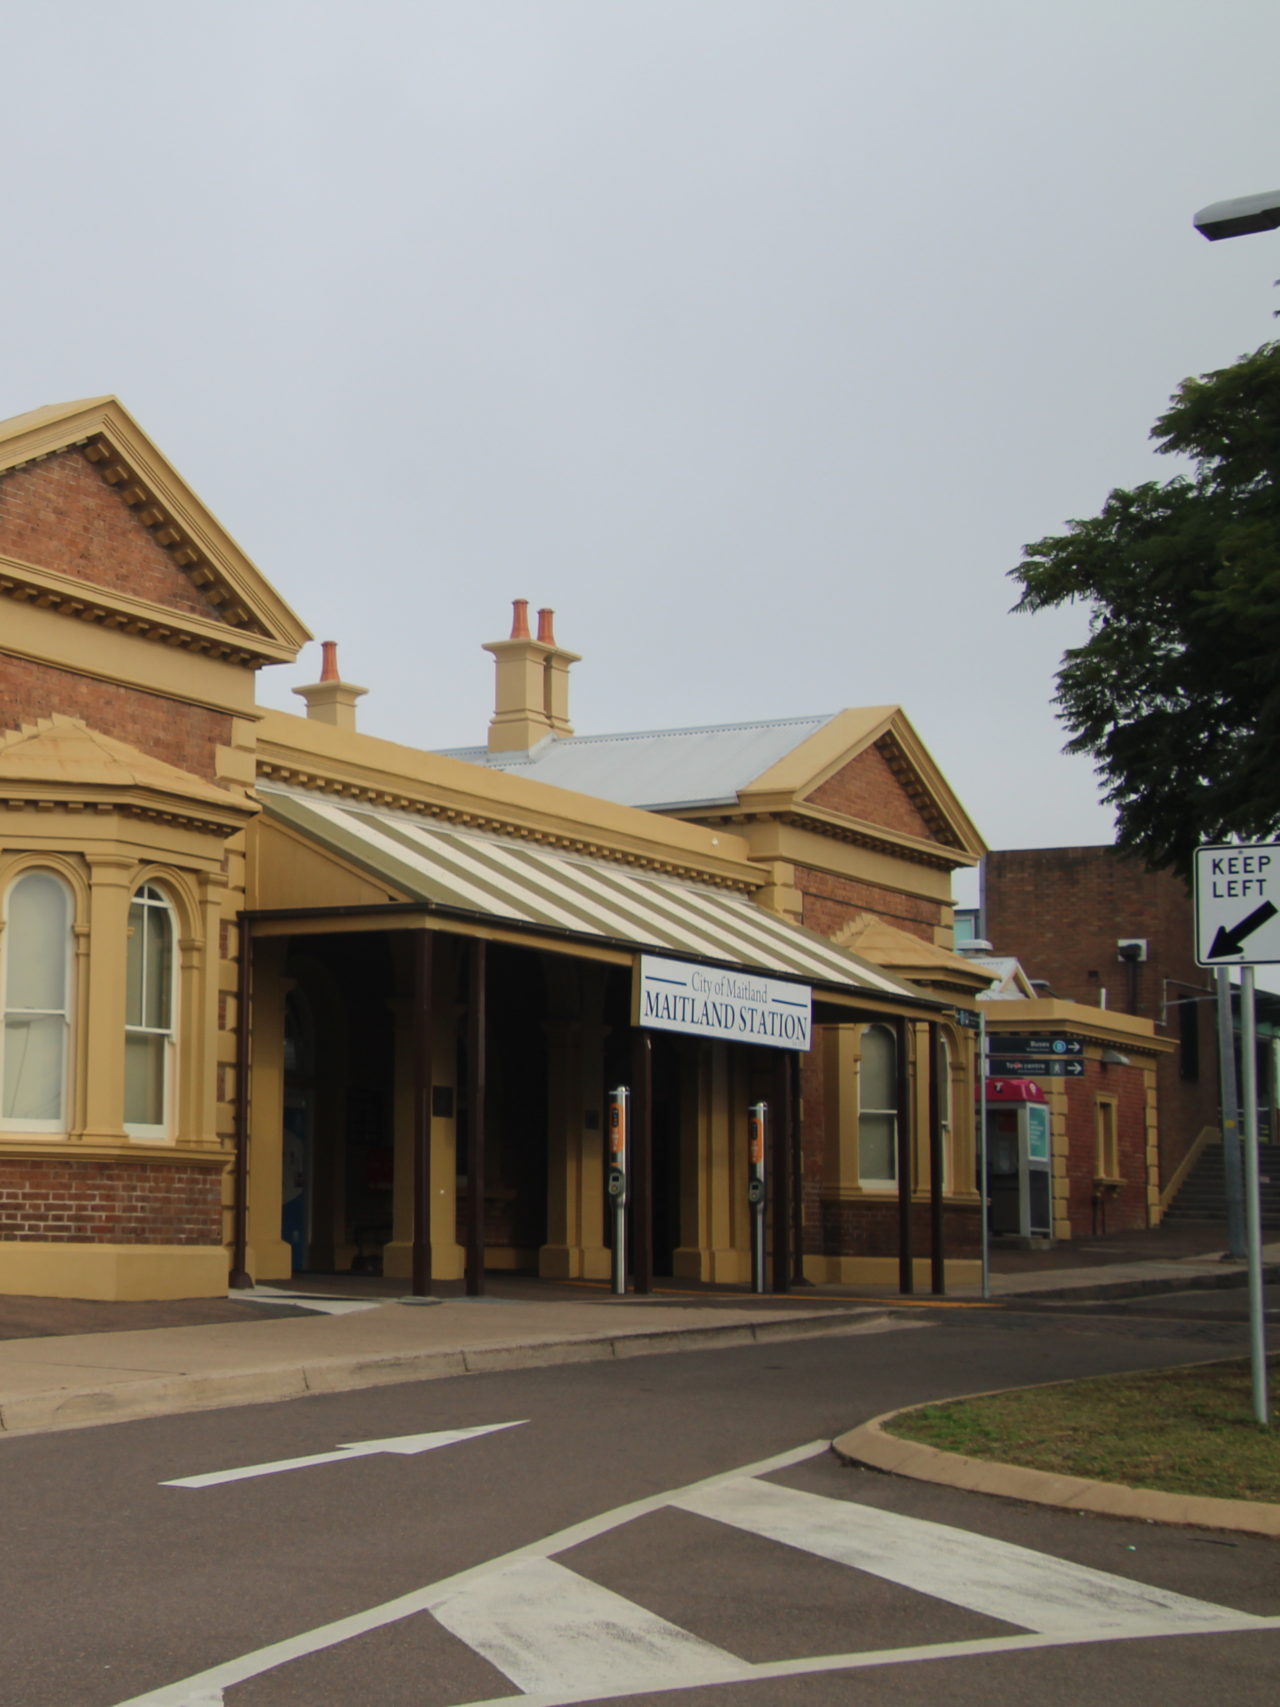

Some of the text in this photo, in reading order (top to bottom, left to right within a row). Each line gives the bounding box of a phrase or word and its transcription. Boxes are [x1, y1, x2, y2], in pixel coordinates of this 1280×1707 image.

[1212, 855, 1271, 875] KEEP
[1212, 879, 1267, 898] LEFT
[691, 971, 768, 1003] City of Maitland
[644, 990, 808, 1041] MAITLAND STATION
[1030, 1040, 1050, 1048] Buses
